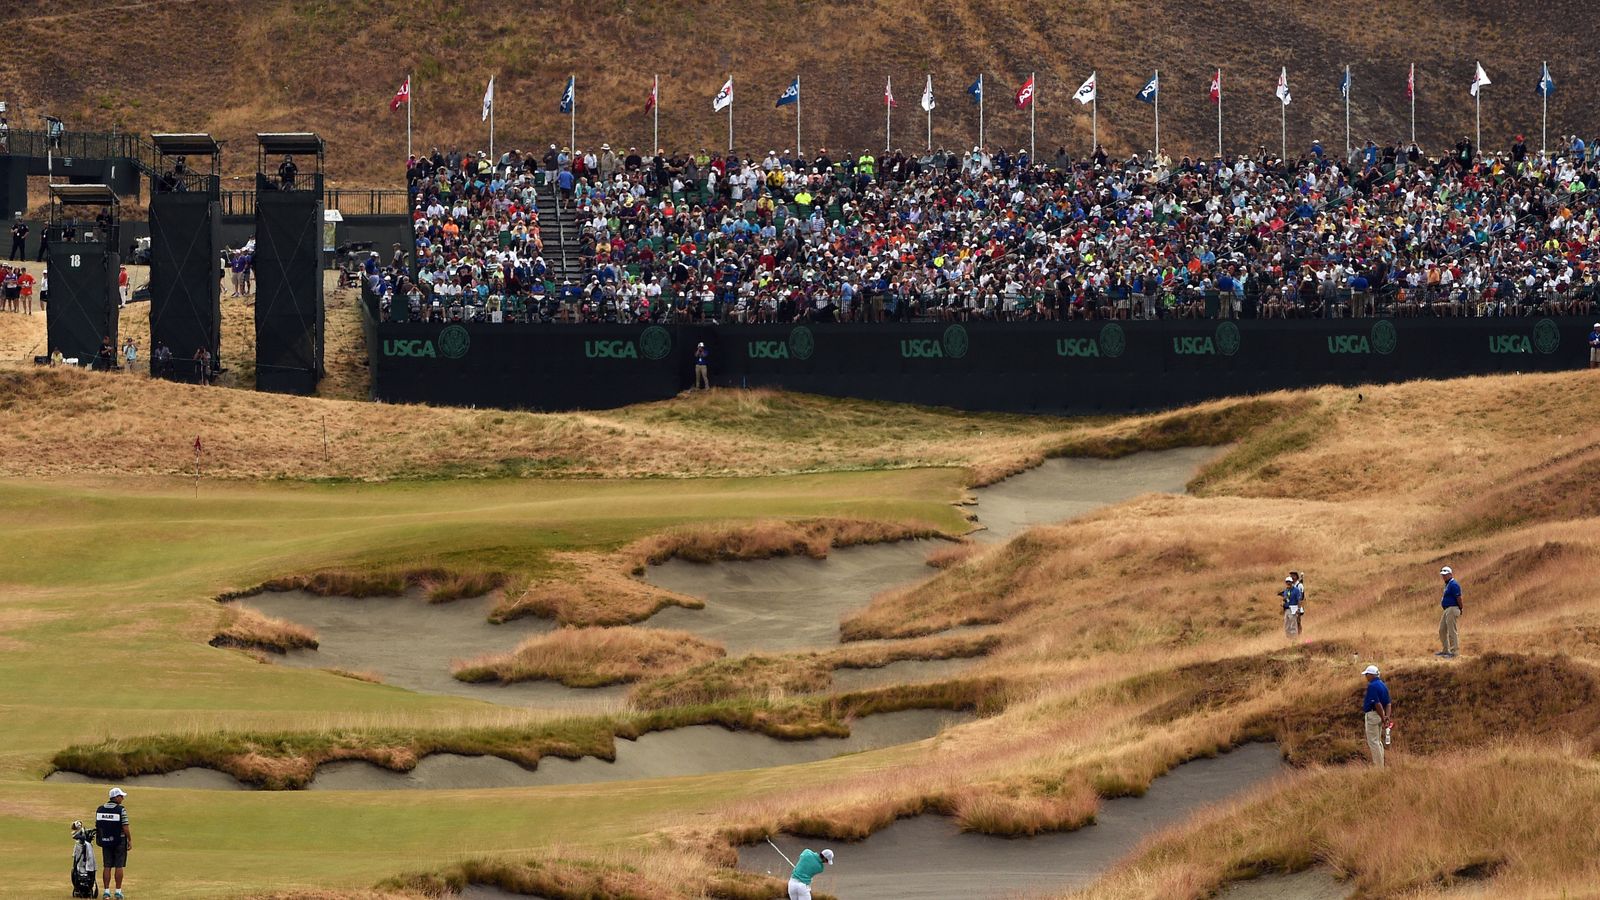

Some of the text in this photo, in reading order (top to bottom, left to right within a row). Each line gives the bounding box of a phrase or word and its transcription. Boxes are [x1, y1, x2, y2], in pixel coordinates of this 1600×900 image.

[70, 254, 81, 267] 18
[384, 340, 437, 357] USGA
[585, 341, 638, 358] USGA
[749, 341, 789, 358] USGA
[901, 340, 943, 357] USGA
[1056, 339, 1100, 357] USGA
[1173, 336, 1216, 354] USGA
[1327, 335, 1370, 353] USGA
[1488, 335, 1533, 353] USGA
